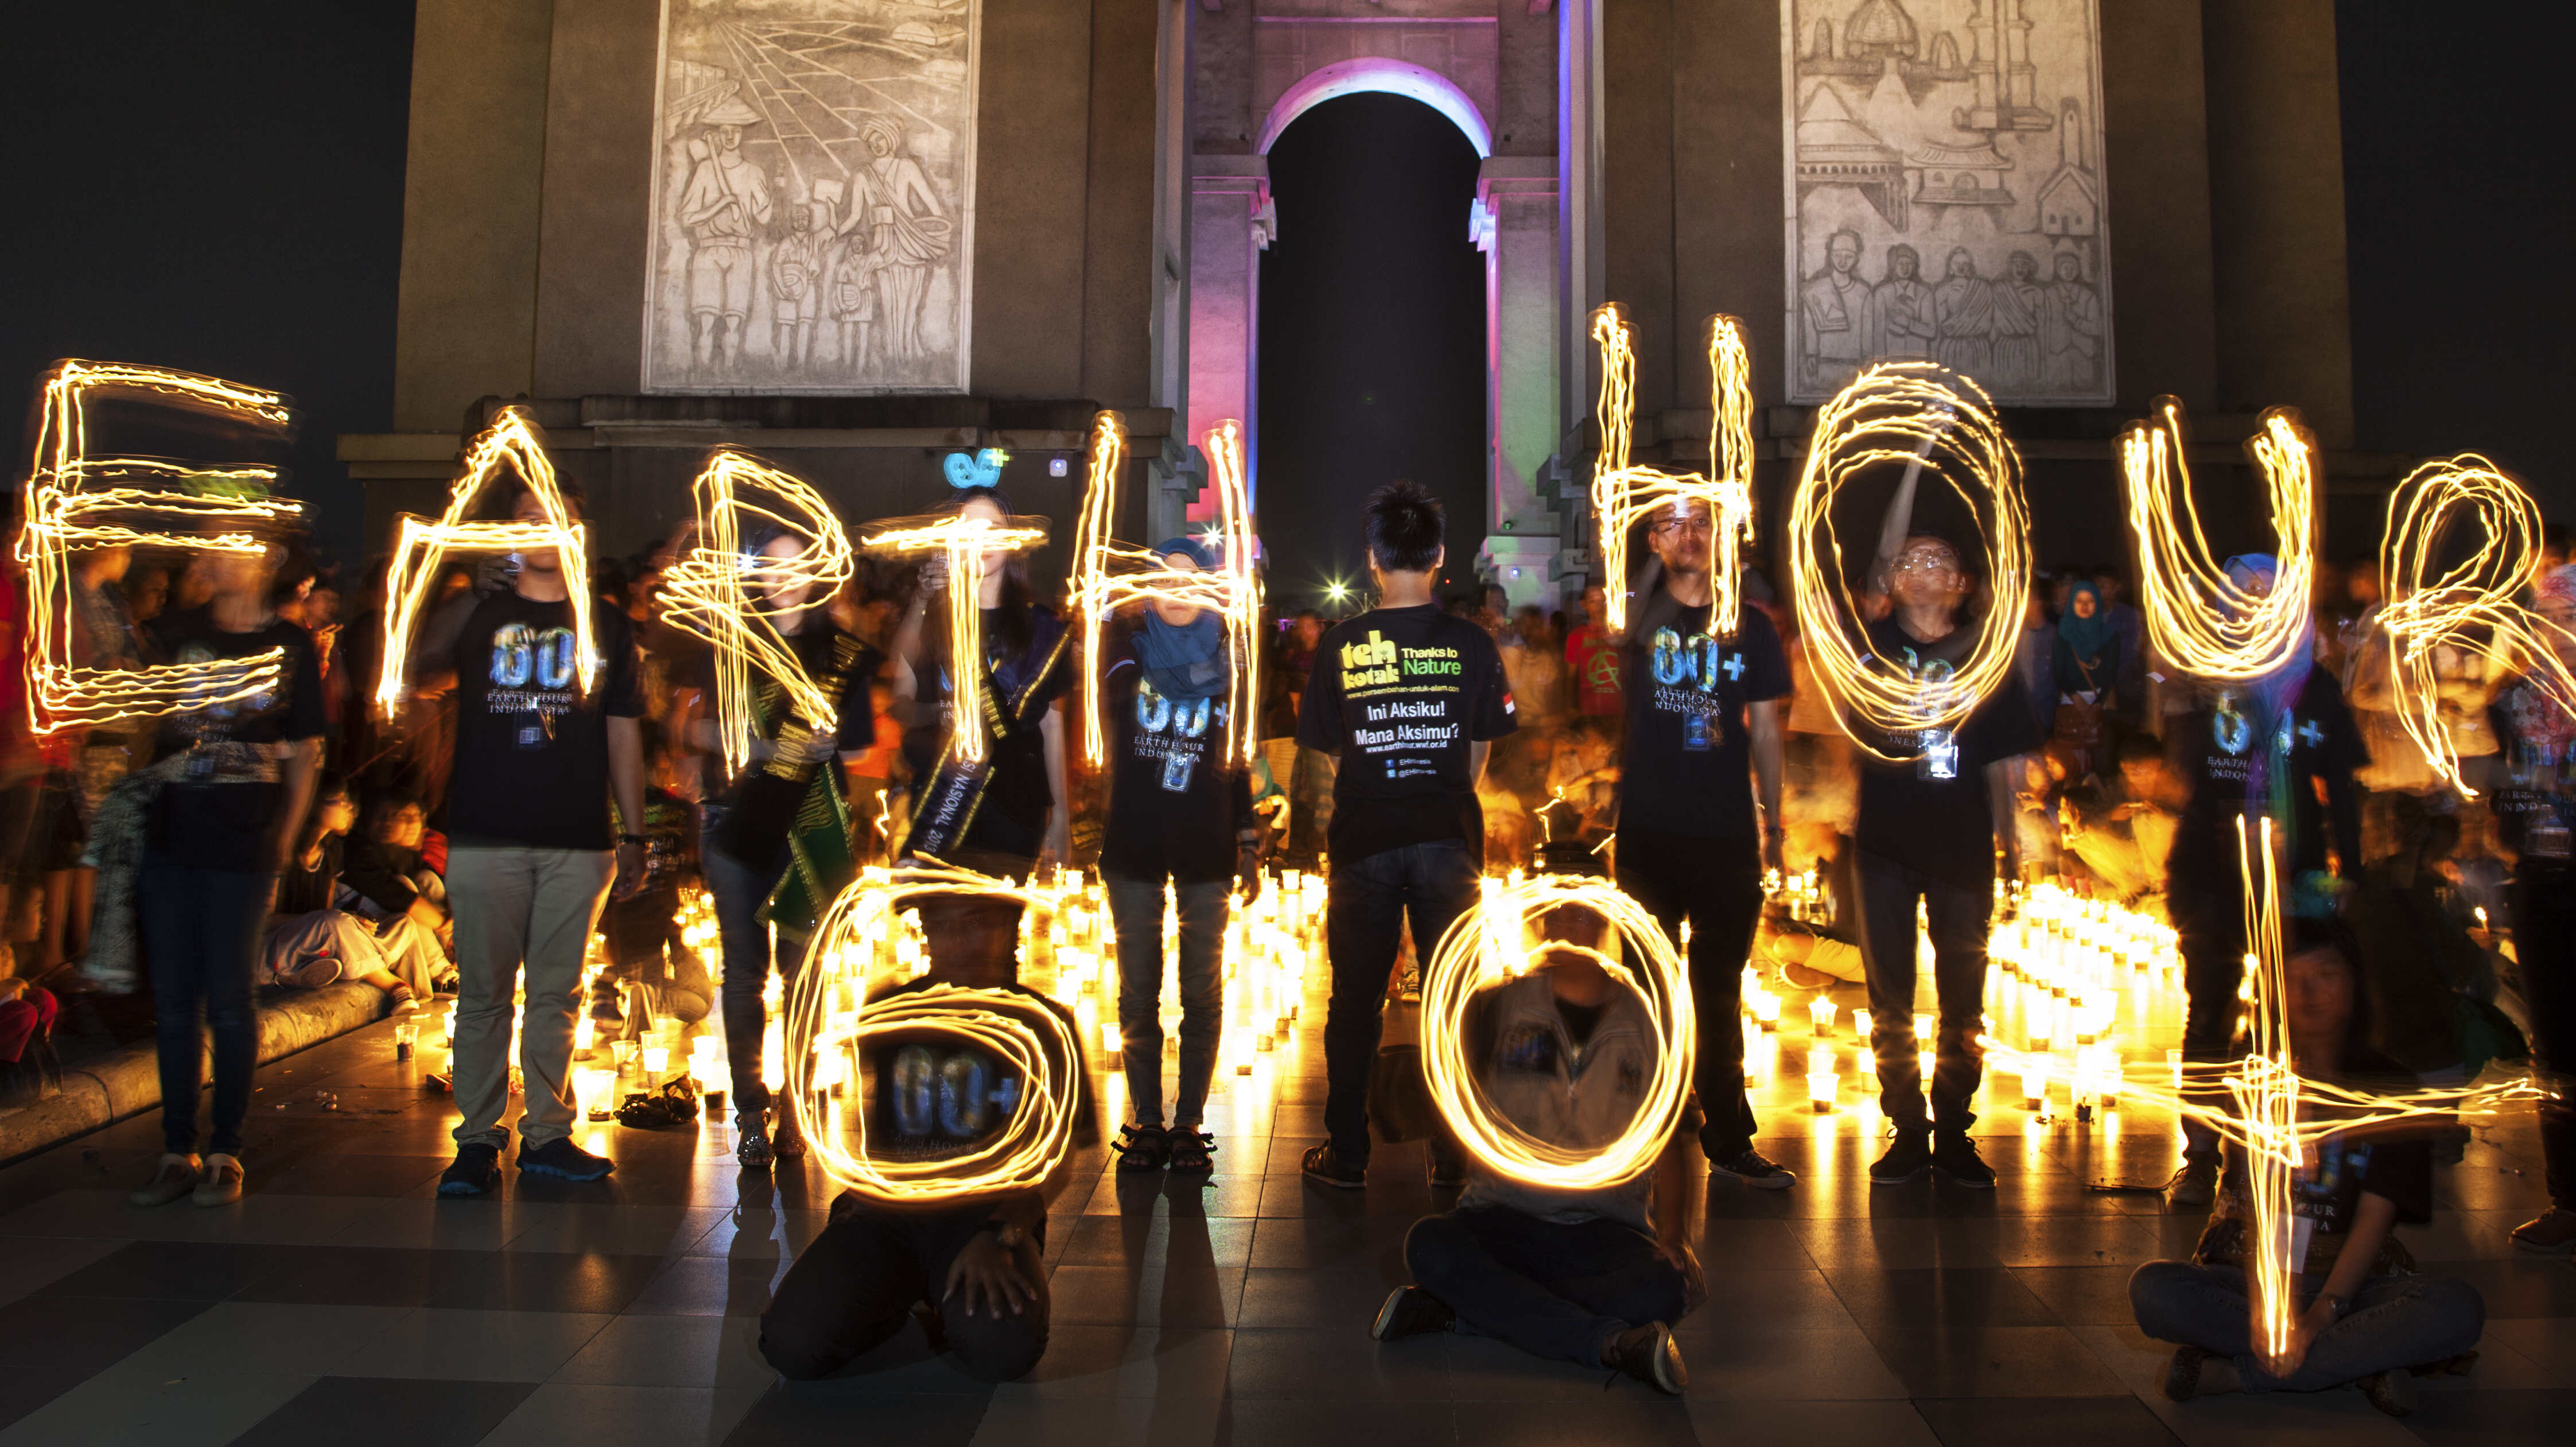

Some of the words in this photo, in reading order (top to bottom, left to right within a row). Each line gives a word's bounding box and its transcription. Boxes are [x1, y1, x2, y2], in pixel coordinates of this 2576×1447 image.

[14, 360, 1261, 779] EARTH
[1591, 304, 2576, 800] HOUR
[1341, 630, 1397, 669] teh
[1401, 647, 1446, 659] Thanks
[1447, 647, 1458, 658] to
[1342, 664, 1400, 690] kotak
[1404, 658, 1462, 675] Nature
[1367, 704, 1387, 721] Ini
[1390, 701, 1445, 718] Aksiku!
[1355, 729, 1395, 745] Mana
[1397, 722, 1459, 741] Aksimu?
[934, 773, 972, 827] NASIONAL
